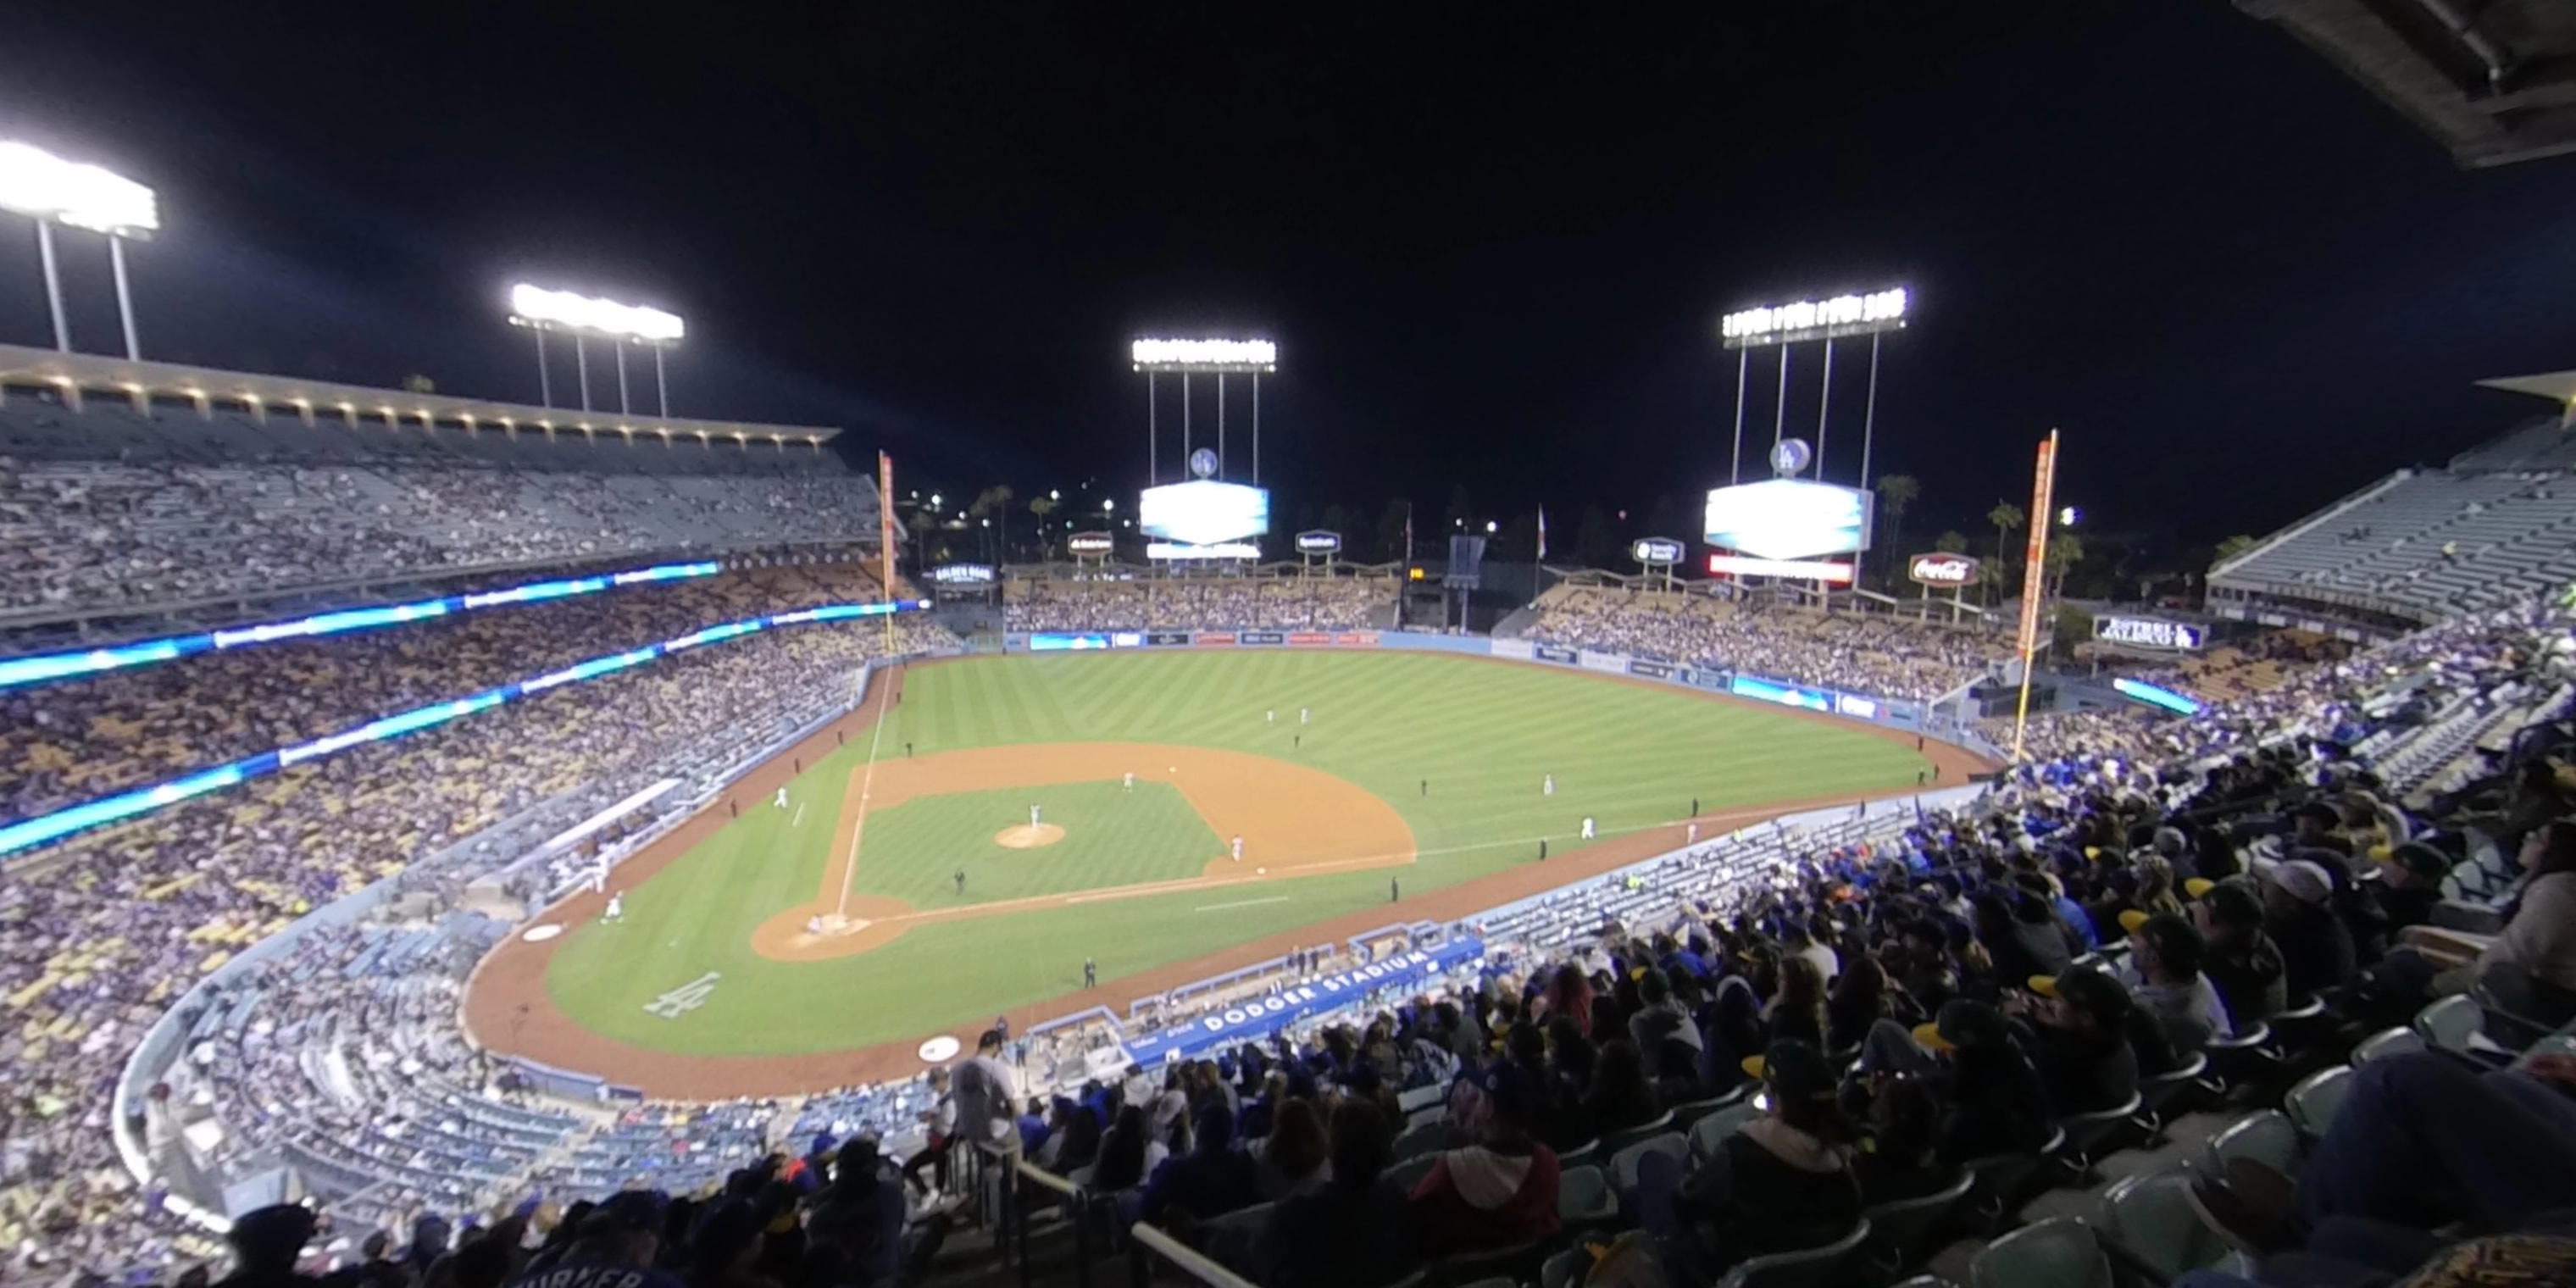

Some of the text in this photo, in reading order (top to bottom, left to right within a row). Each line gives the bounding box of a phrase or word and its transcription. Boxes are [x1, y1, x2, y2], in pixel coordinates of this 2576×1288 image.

[1779, 443, 1796, 469] LA
[1203, 951, 1429, 1031] DODGER STADIUM
[511, 1266, 645, 1288] URNER
